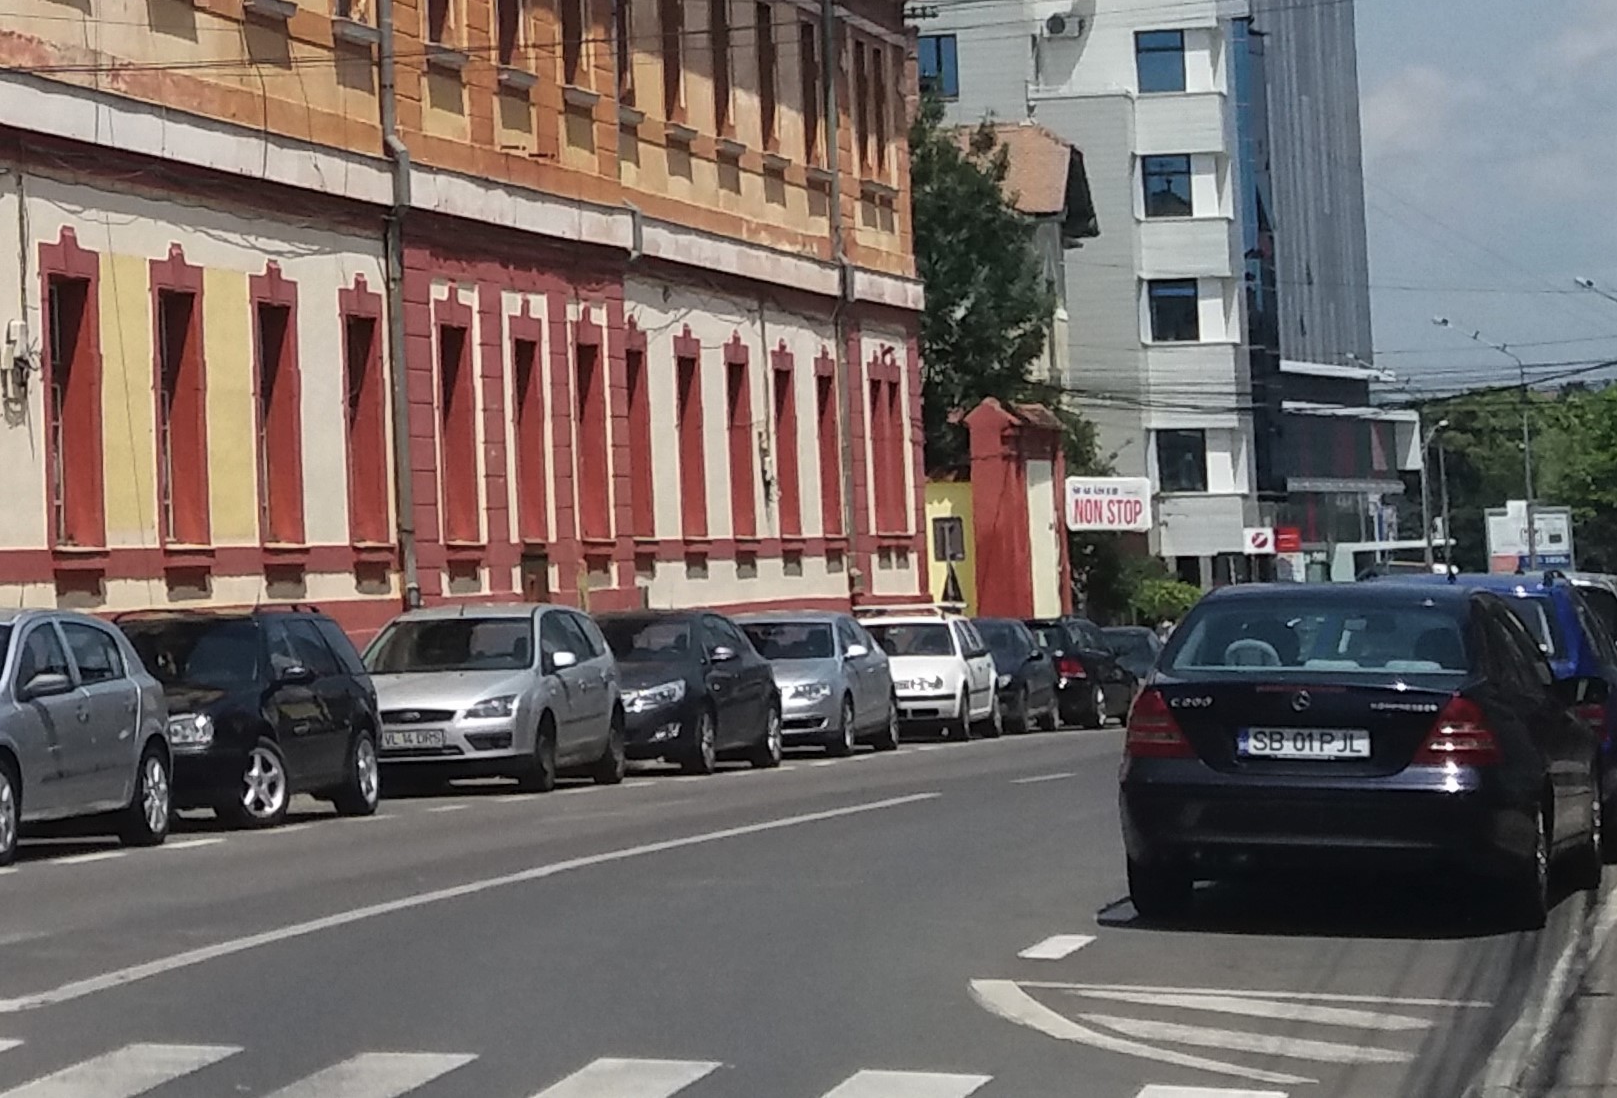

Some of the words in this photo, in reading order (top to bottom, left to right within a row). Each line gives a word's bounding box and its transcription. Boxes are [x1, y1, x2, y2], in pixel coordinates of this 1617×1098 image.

[1074, 499, 1103, 524] NON
[1107, 499, 1142, 525] STOP
[1253, 731, 1284, 751] SB
[1293, 732, 1313, 752] 01
[1319, 732, 1362, 753] PJL
